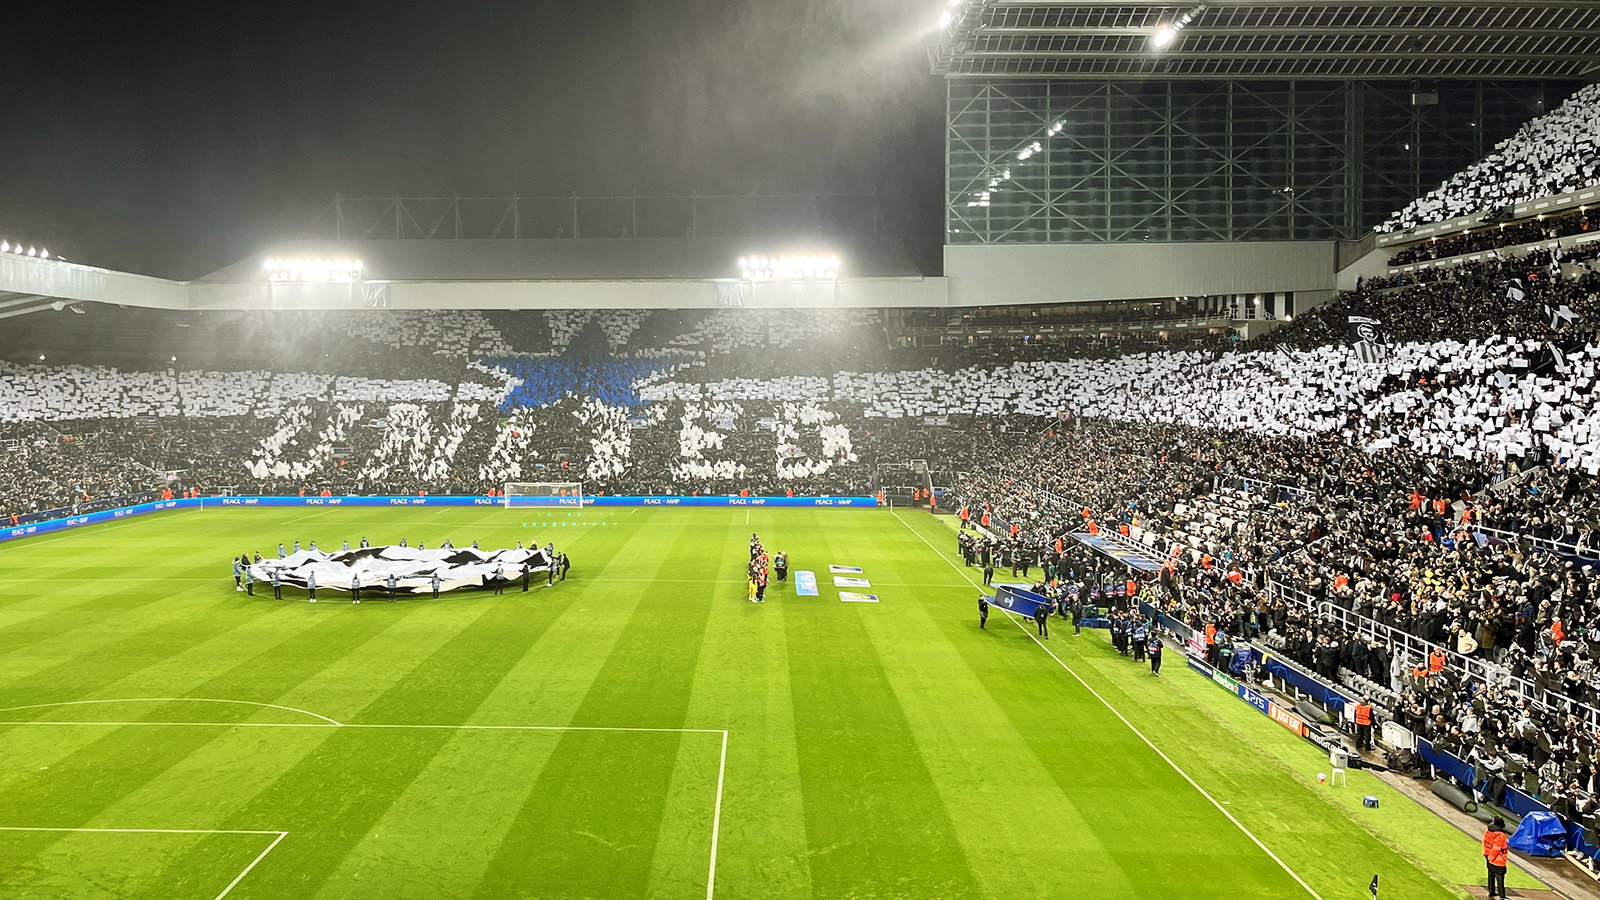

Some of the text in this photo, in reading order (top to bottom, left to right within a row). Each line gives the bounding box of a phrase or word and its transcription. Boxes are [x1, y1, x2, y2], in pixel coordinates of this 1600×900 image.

[243, 400, 858, 480] UNITED
[1249, 693, 1265, 709] PS5
[1276, 709, 1300, 731] JUST EAT
